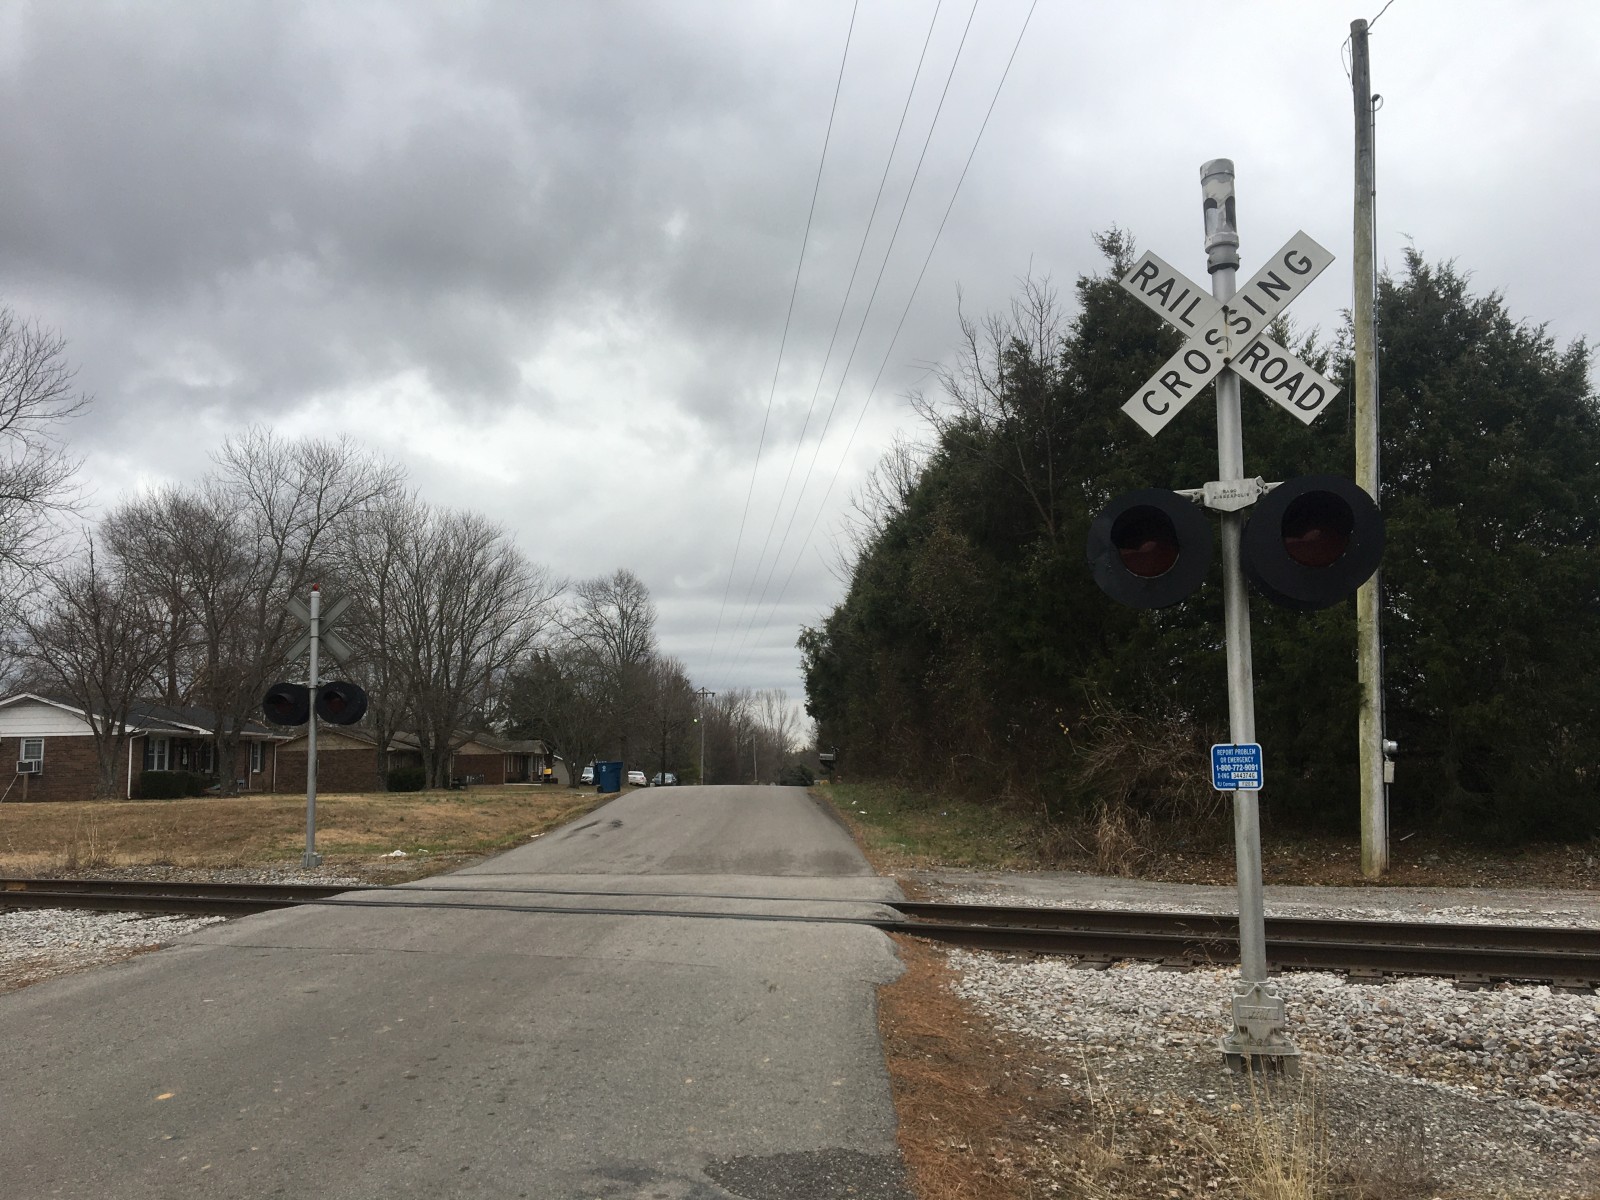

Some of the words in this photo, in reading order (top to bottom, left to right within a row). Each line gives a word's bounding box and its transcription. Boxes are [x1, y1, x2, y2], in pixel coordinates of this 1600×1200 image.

[1129, 260, 1202, 328] RAIL
[1238, 341, 1326, 411] ROAD
[1142, 250, 1313, 416] CROSSING
